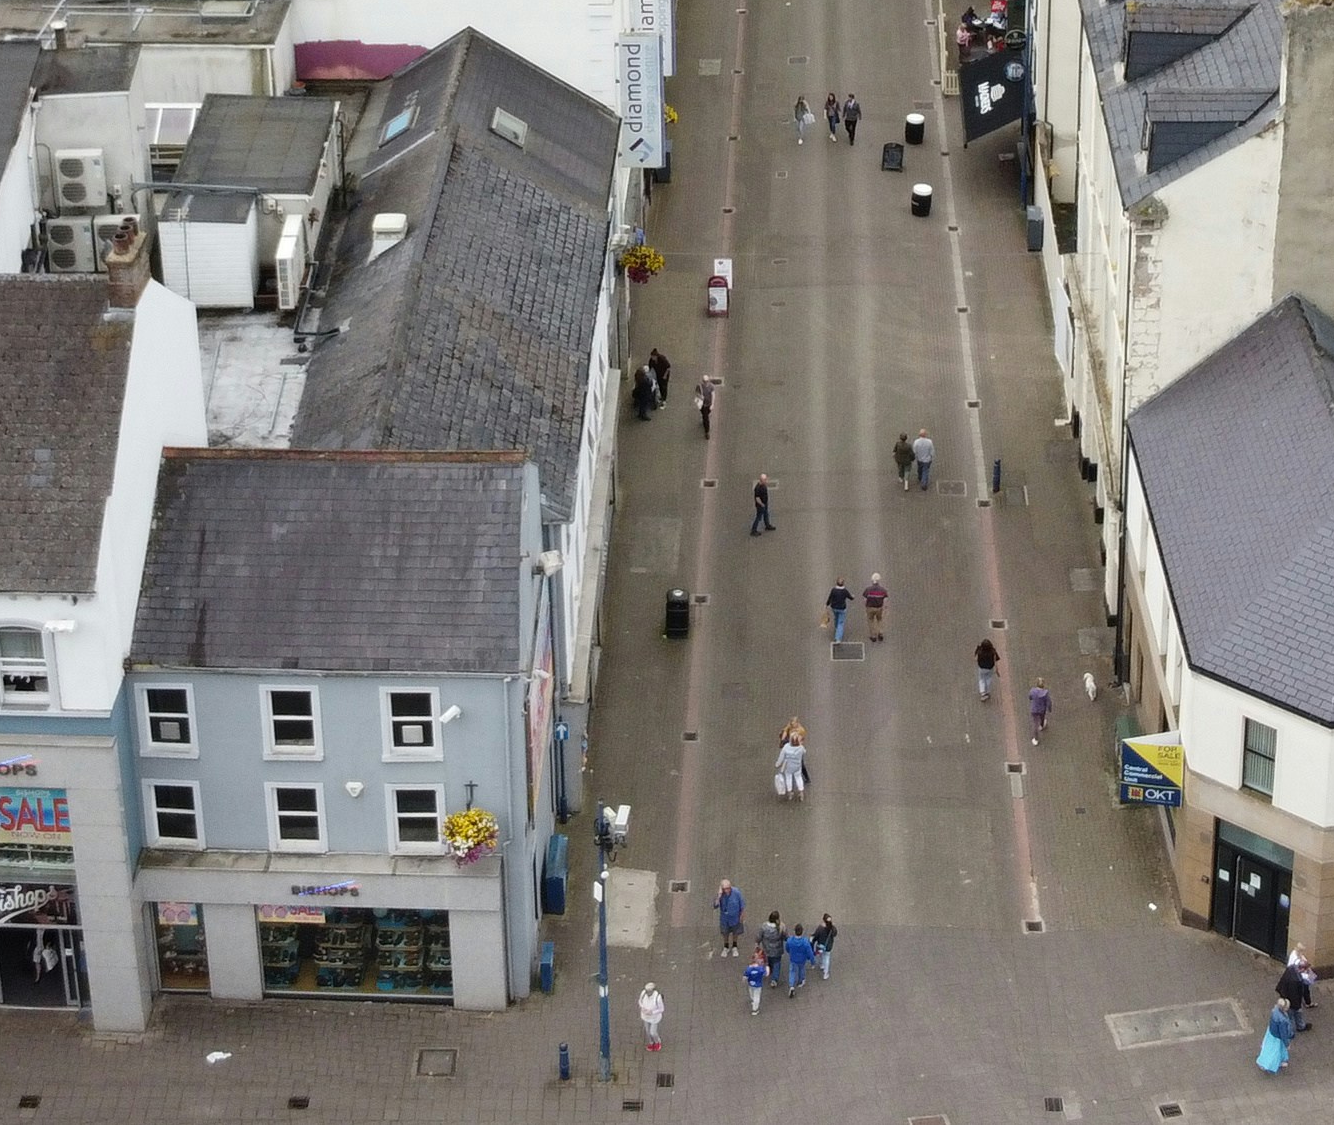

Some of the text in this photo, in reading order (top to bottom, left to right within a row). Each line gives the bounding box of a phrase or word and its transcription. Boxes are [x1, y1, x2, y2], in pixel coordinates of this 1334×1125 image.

[622, 44, 643, 133] diamond
[1124, 764, 1148, 772] Central
[1145, 789, 1175, 800] OKT
[291, 883, 360, 897] BISHOPS
